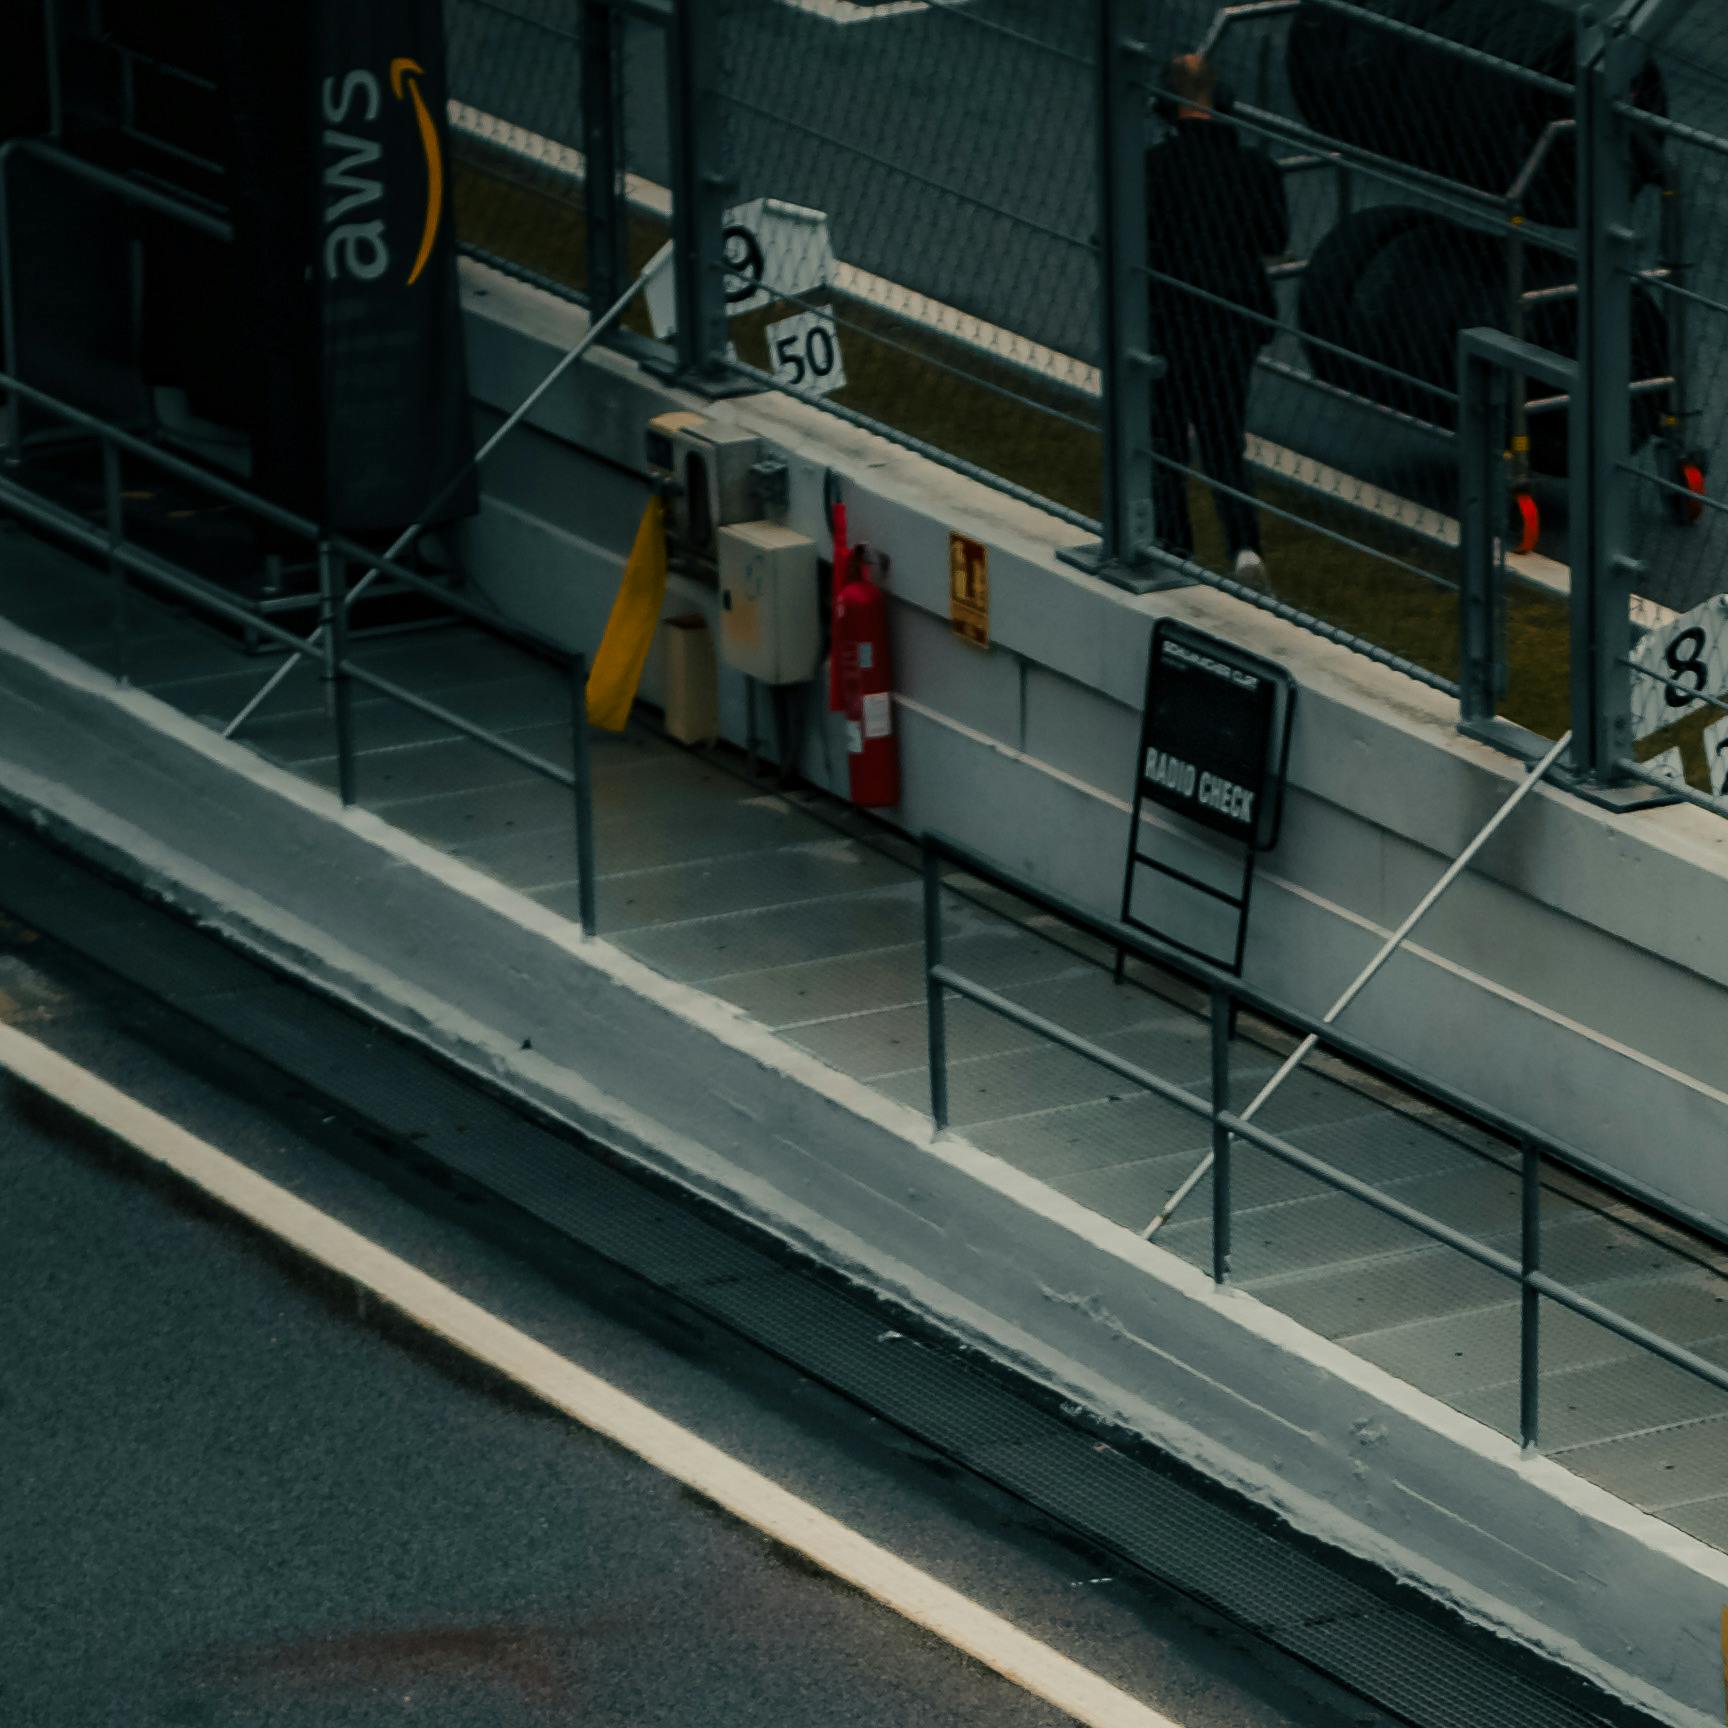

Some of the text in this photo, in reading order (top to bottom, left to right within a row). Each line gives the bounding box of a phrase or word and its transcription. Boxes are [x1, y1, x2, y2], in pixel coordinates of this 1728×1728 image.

[322, 68, 389, 282] aws
[777, 326, 833, 385] 50
[1665, 627, 1707, 707] 8
[1143, 746, 1257, 823] RADIO CHECK
